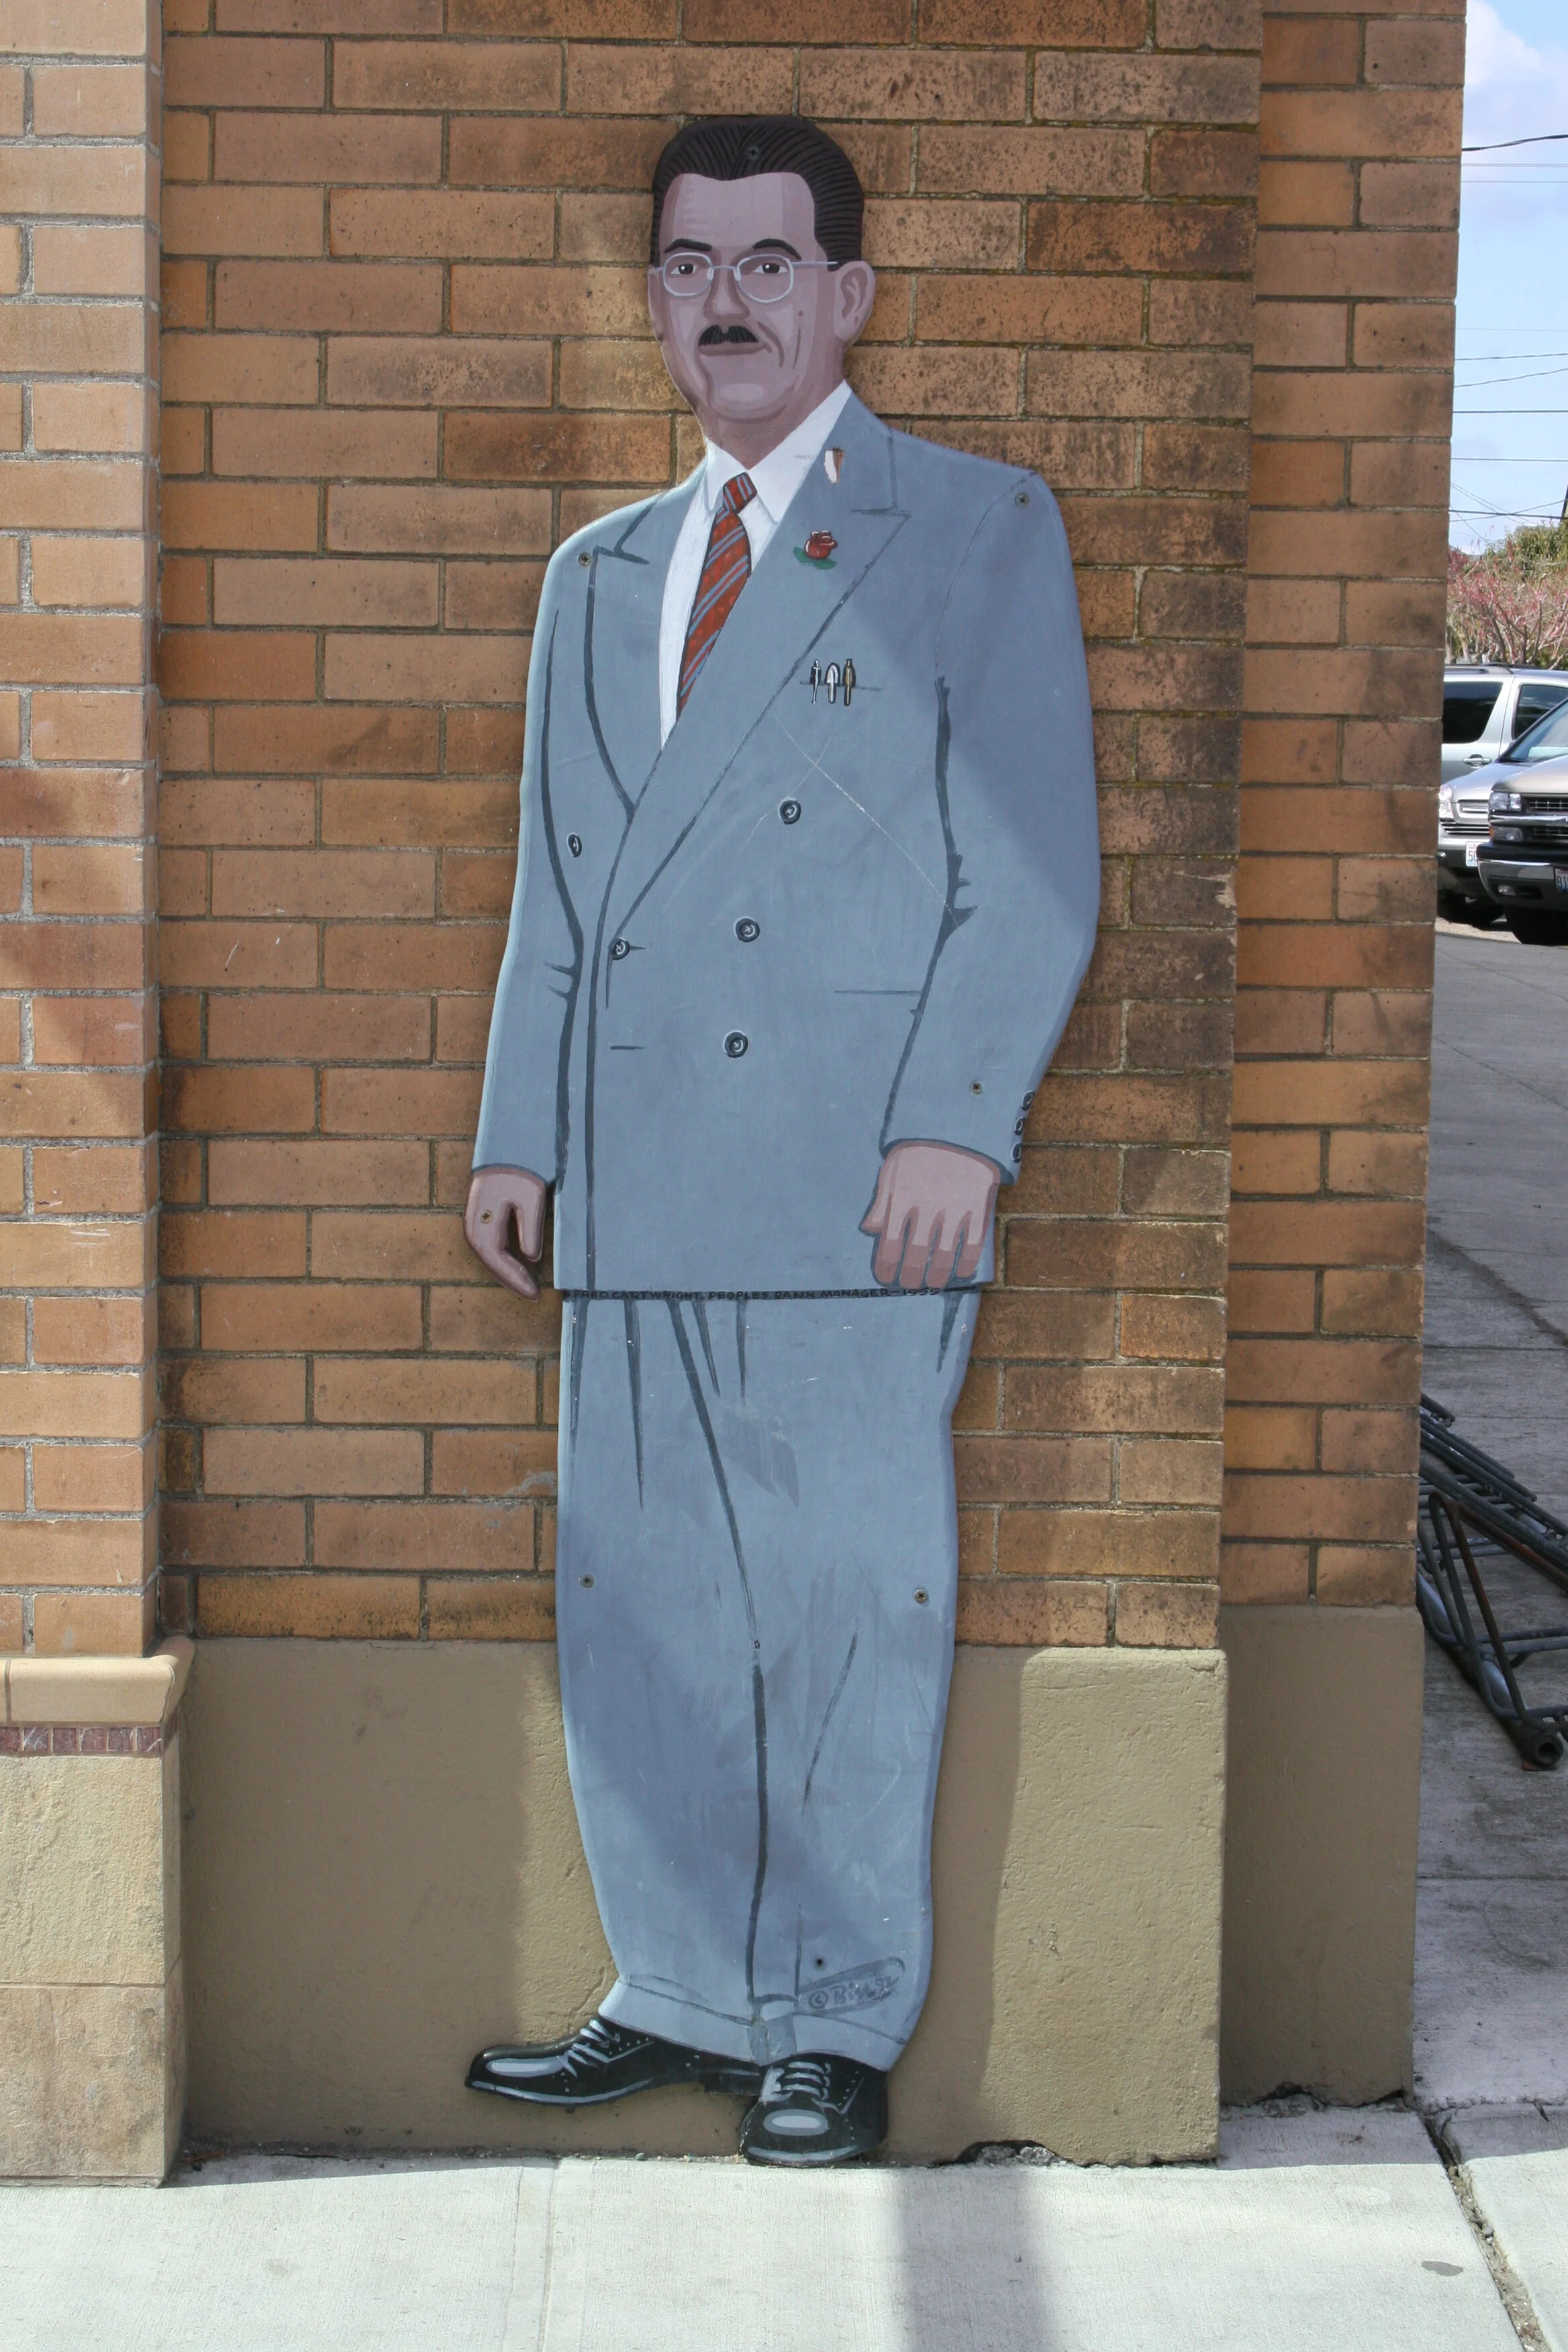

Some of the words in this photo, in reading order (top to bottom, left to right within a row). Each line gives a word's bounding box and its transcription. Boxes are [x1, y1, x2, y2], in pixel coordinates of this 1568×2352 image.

[574, 1290, 607, 1298] FRED
[707, 1291, 769, 1300] PEOPLES
[774, 1290, 815, 1298] BANK
